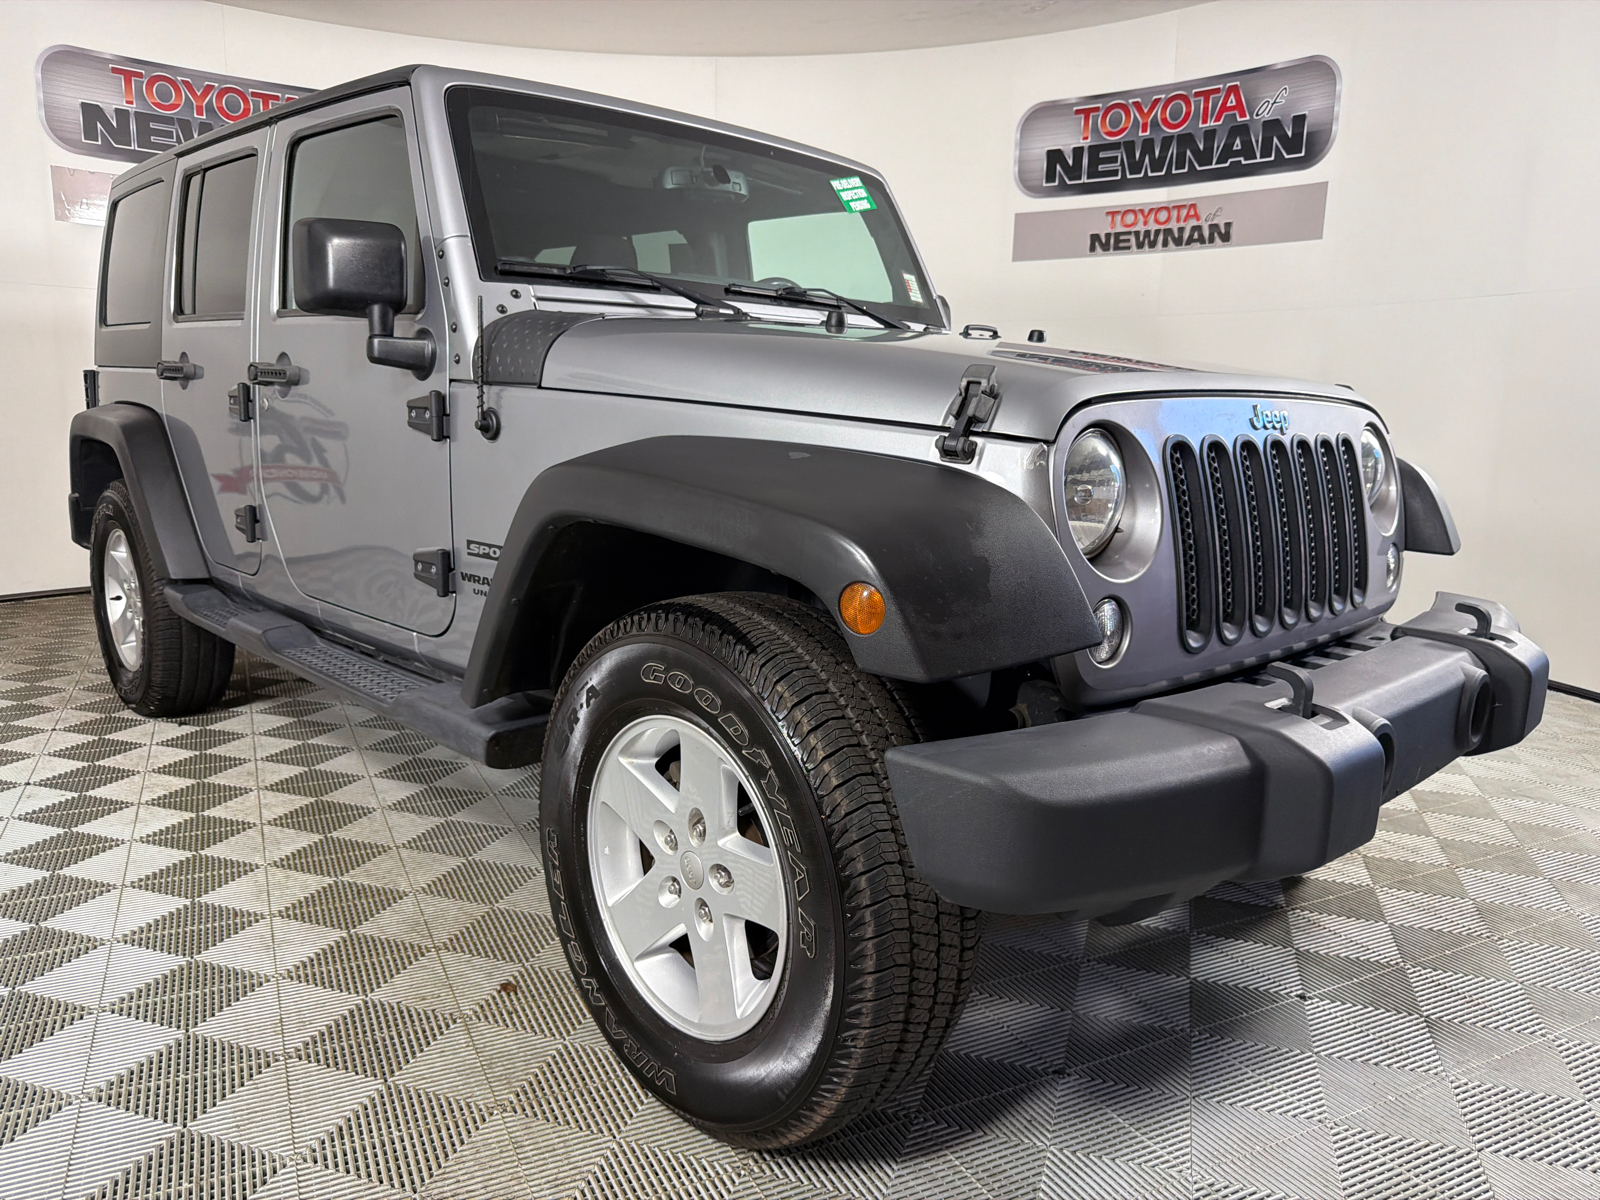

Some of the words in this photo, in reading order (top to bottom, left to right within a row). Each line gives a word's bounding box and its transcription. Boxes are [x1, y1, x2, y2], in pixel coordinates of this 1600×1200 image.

[109, 64, 300, 122] TOYOT
[1073, 82, 1250, 142] TOYOTA
[1254, 86, 1289, 118] of
[79, 100, 227, 153] NEW
[1042, 112, 1308, 186] NEWNAN
[1105, 203, 1202, 230] TOYOTA
[1204, 207, 1223, 222] of
[1088, 222, 1234, 254] NEWNAN
[1249, 404, 1290, 435] Jeep
[468, 543, 502, 558] SPO
[460, 571, 493, 587] WRA
[473, 588, 488, 598] UN
[640, 661, 817, 960] GOODYEAR
[546, 826, 678, 1096] WRANGLER
